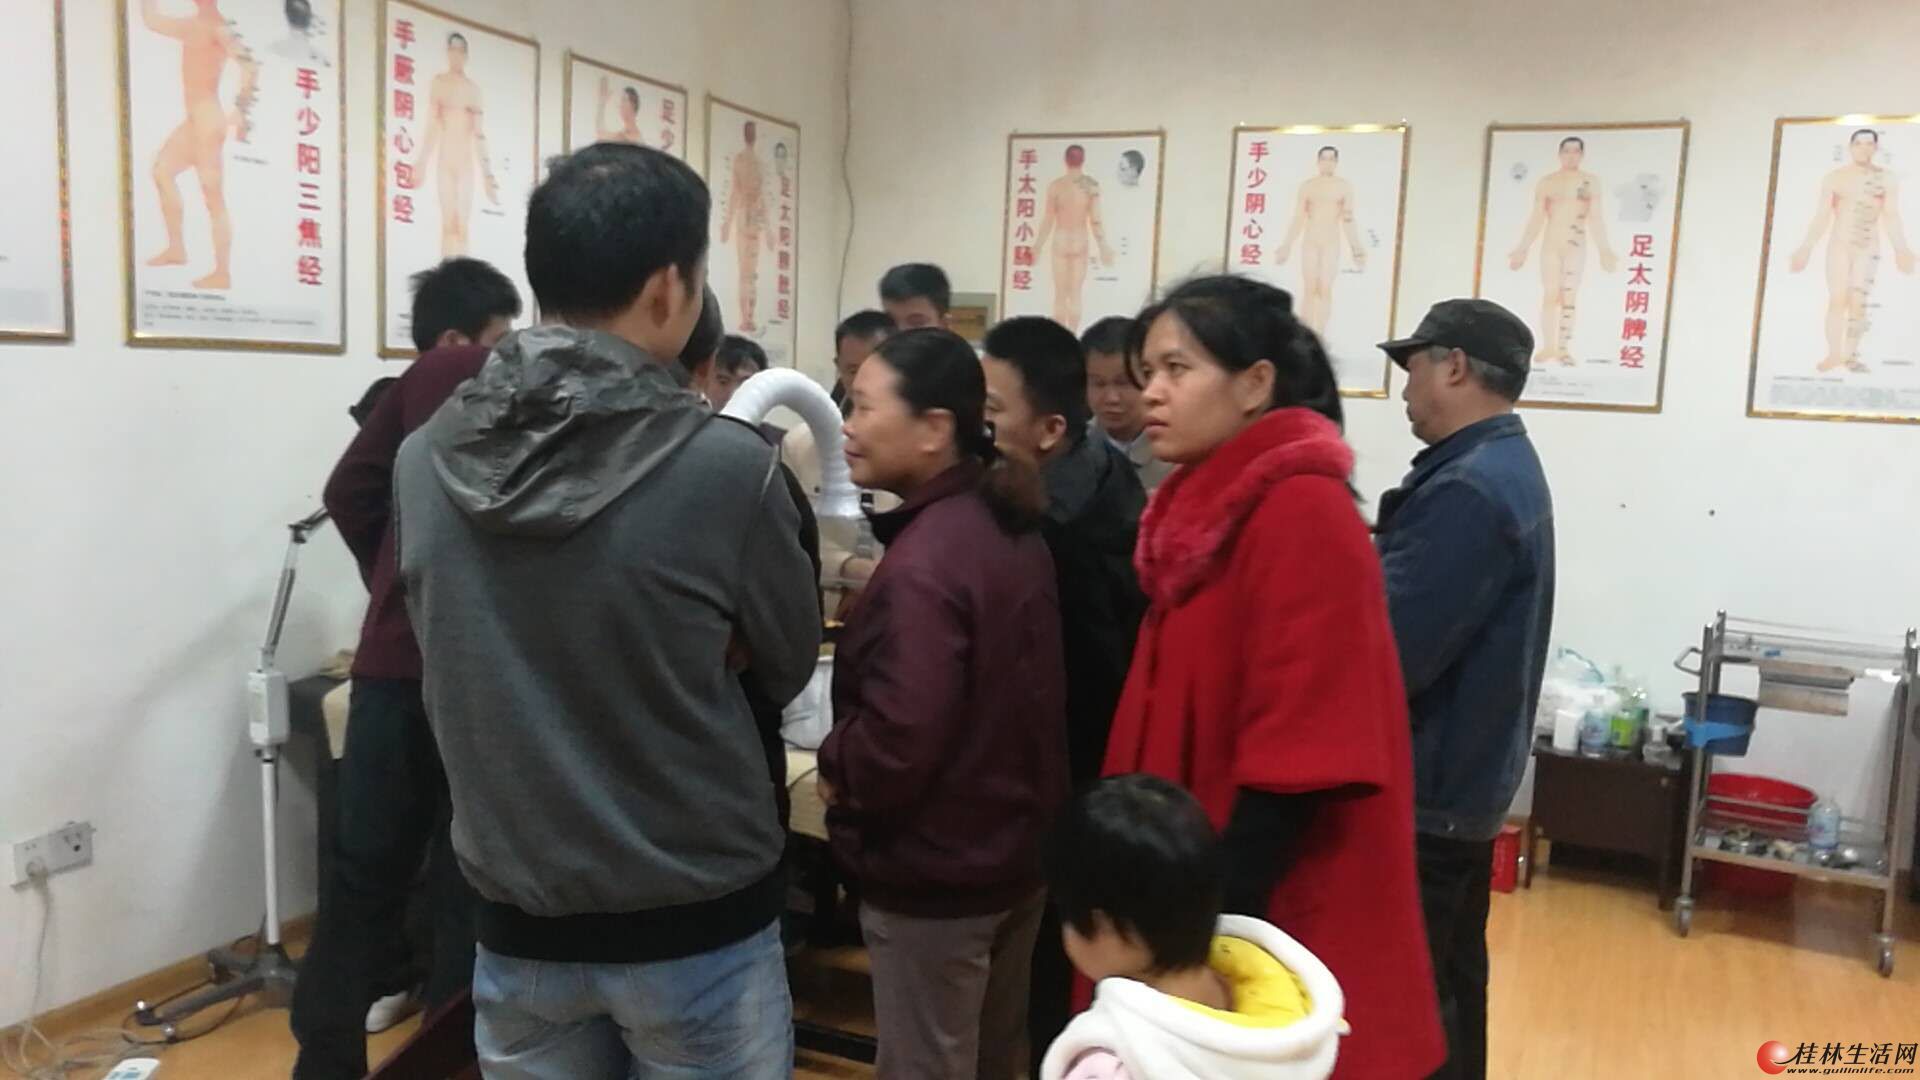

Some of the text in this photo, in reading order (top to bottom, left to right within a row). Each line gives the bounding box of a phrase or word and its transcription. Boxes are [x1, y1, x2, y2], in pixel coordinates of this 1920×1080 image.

[295, 67, 323, 286] 手少阳三焦经
[1012, 150, 1038, 290] 手太阳小肠经
[1240, 141, 1269, 266] 手少阴心经
[1619, 234, 1654, 369] 足太阴脾经
